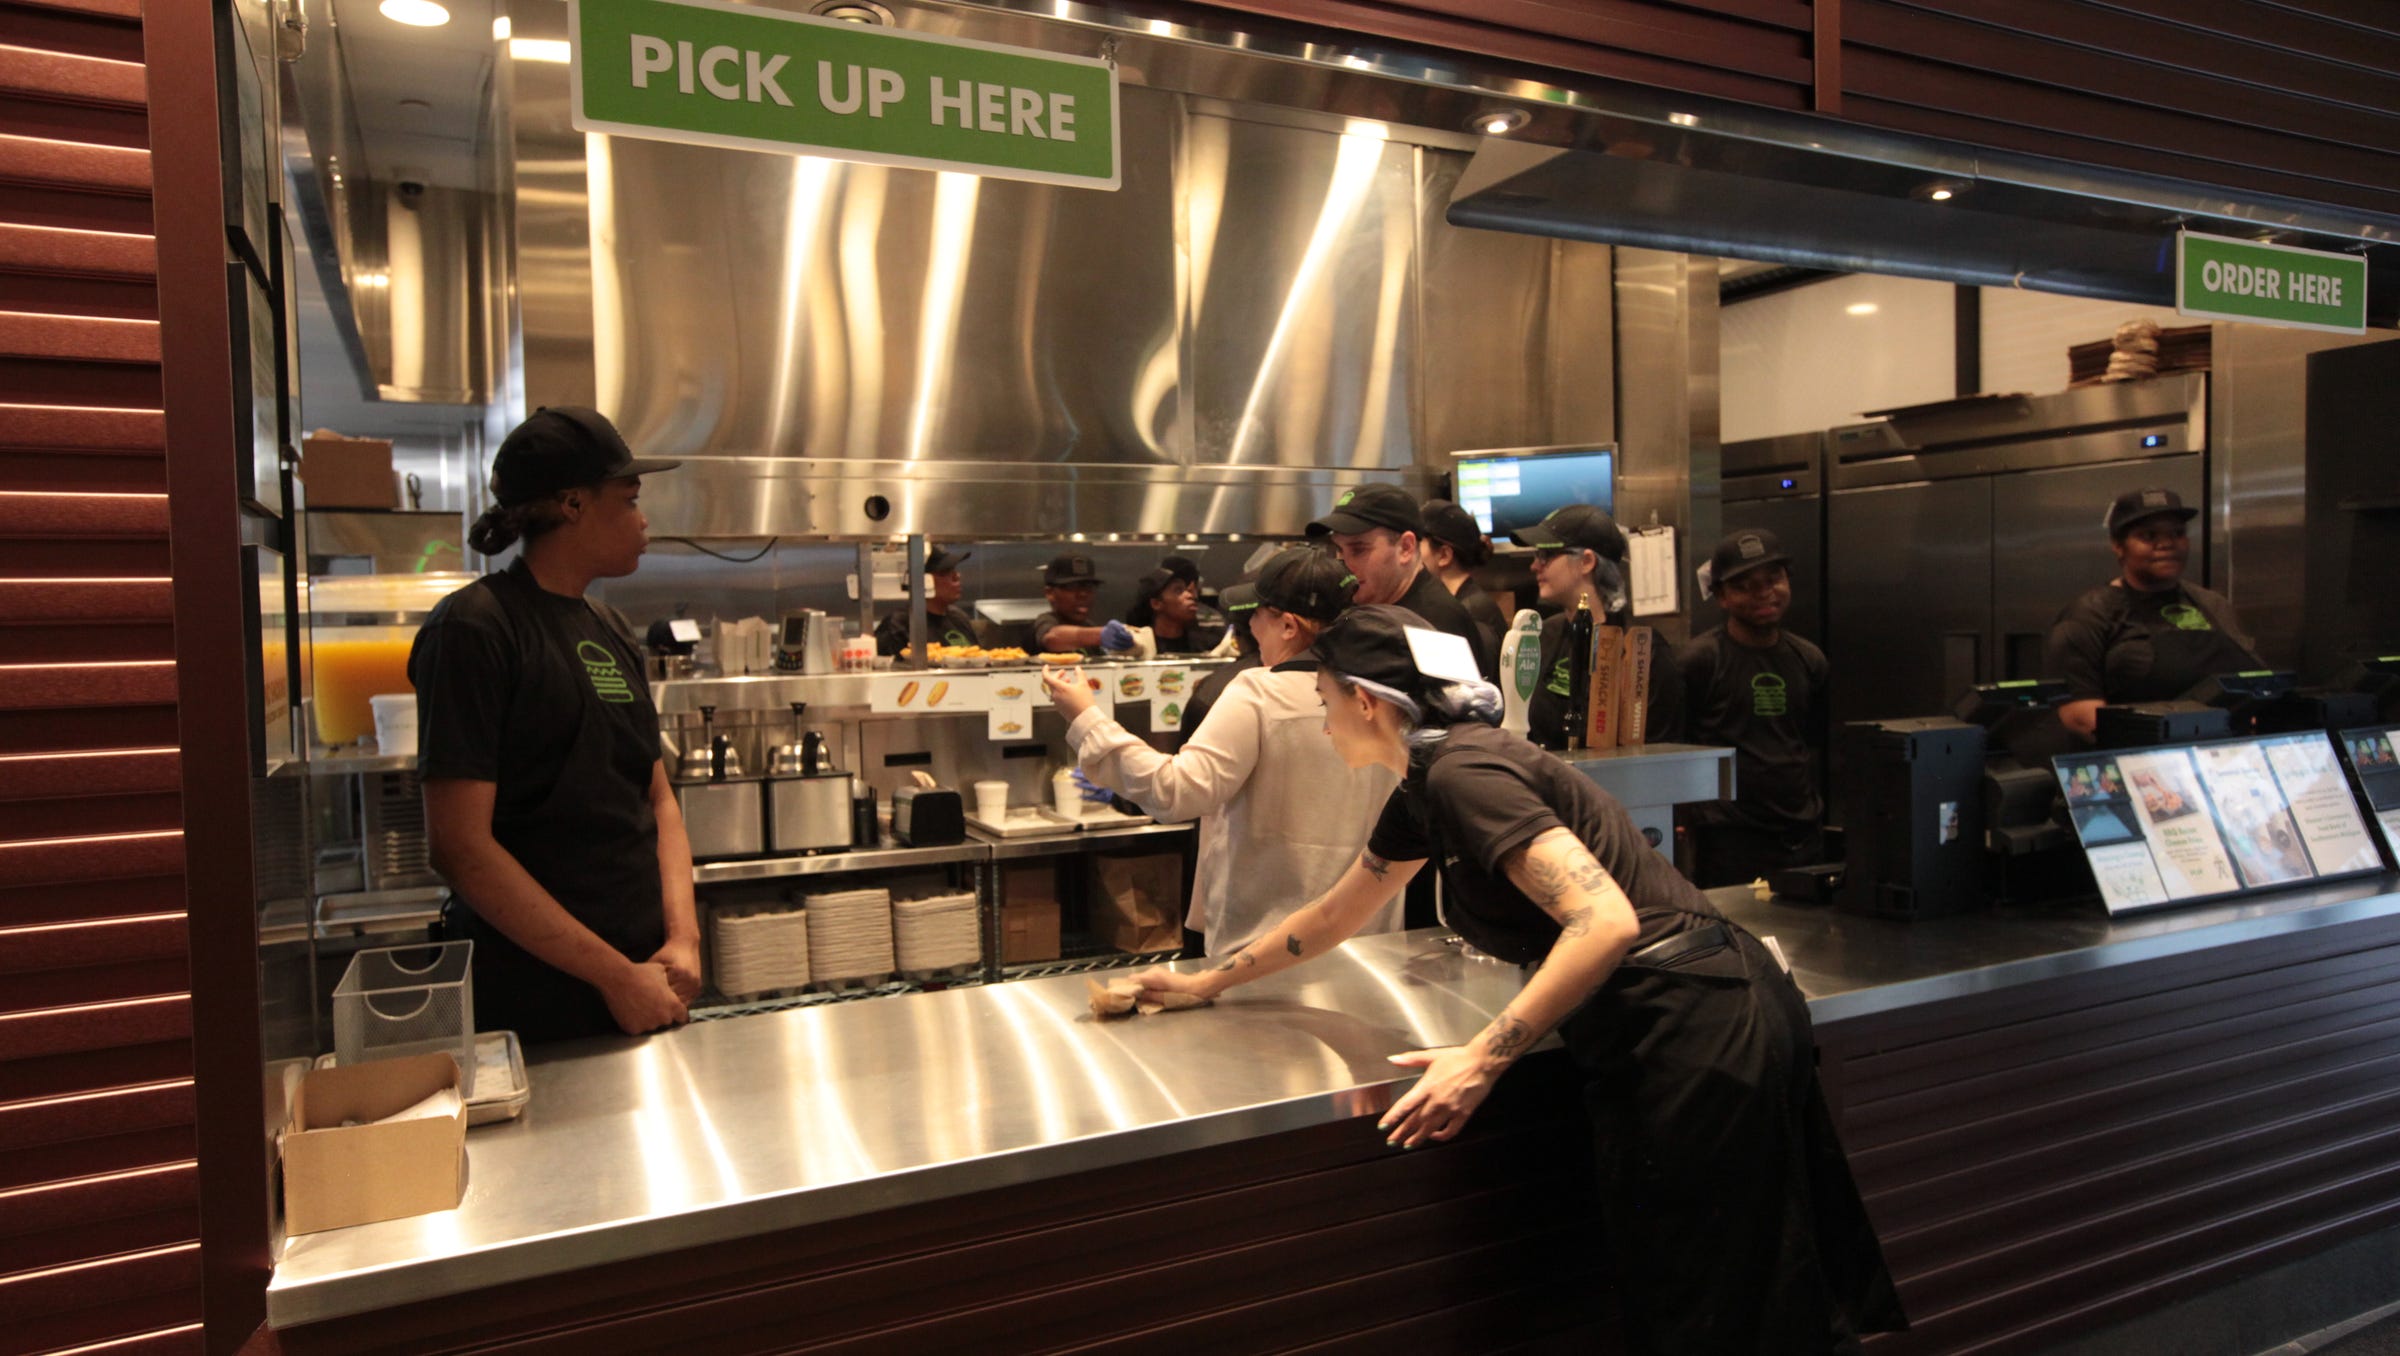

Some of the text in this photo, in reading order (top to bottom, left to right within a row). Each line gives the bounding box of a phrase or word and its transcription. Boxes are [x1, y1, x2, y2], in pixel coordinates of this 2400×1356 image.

[630, 33, 1077, 142] PICK UP HERE
[2202, 260, 2343, 307] ORDER HERE
[1519, 658, 1536, 671] Ale
[1632, 659, 1645, 739] SHACK WHITE
[1596, 665, 1610, 734] SHACK RED
